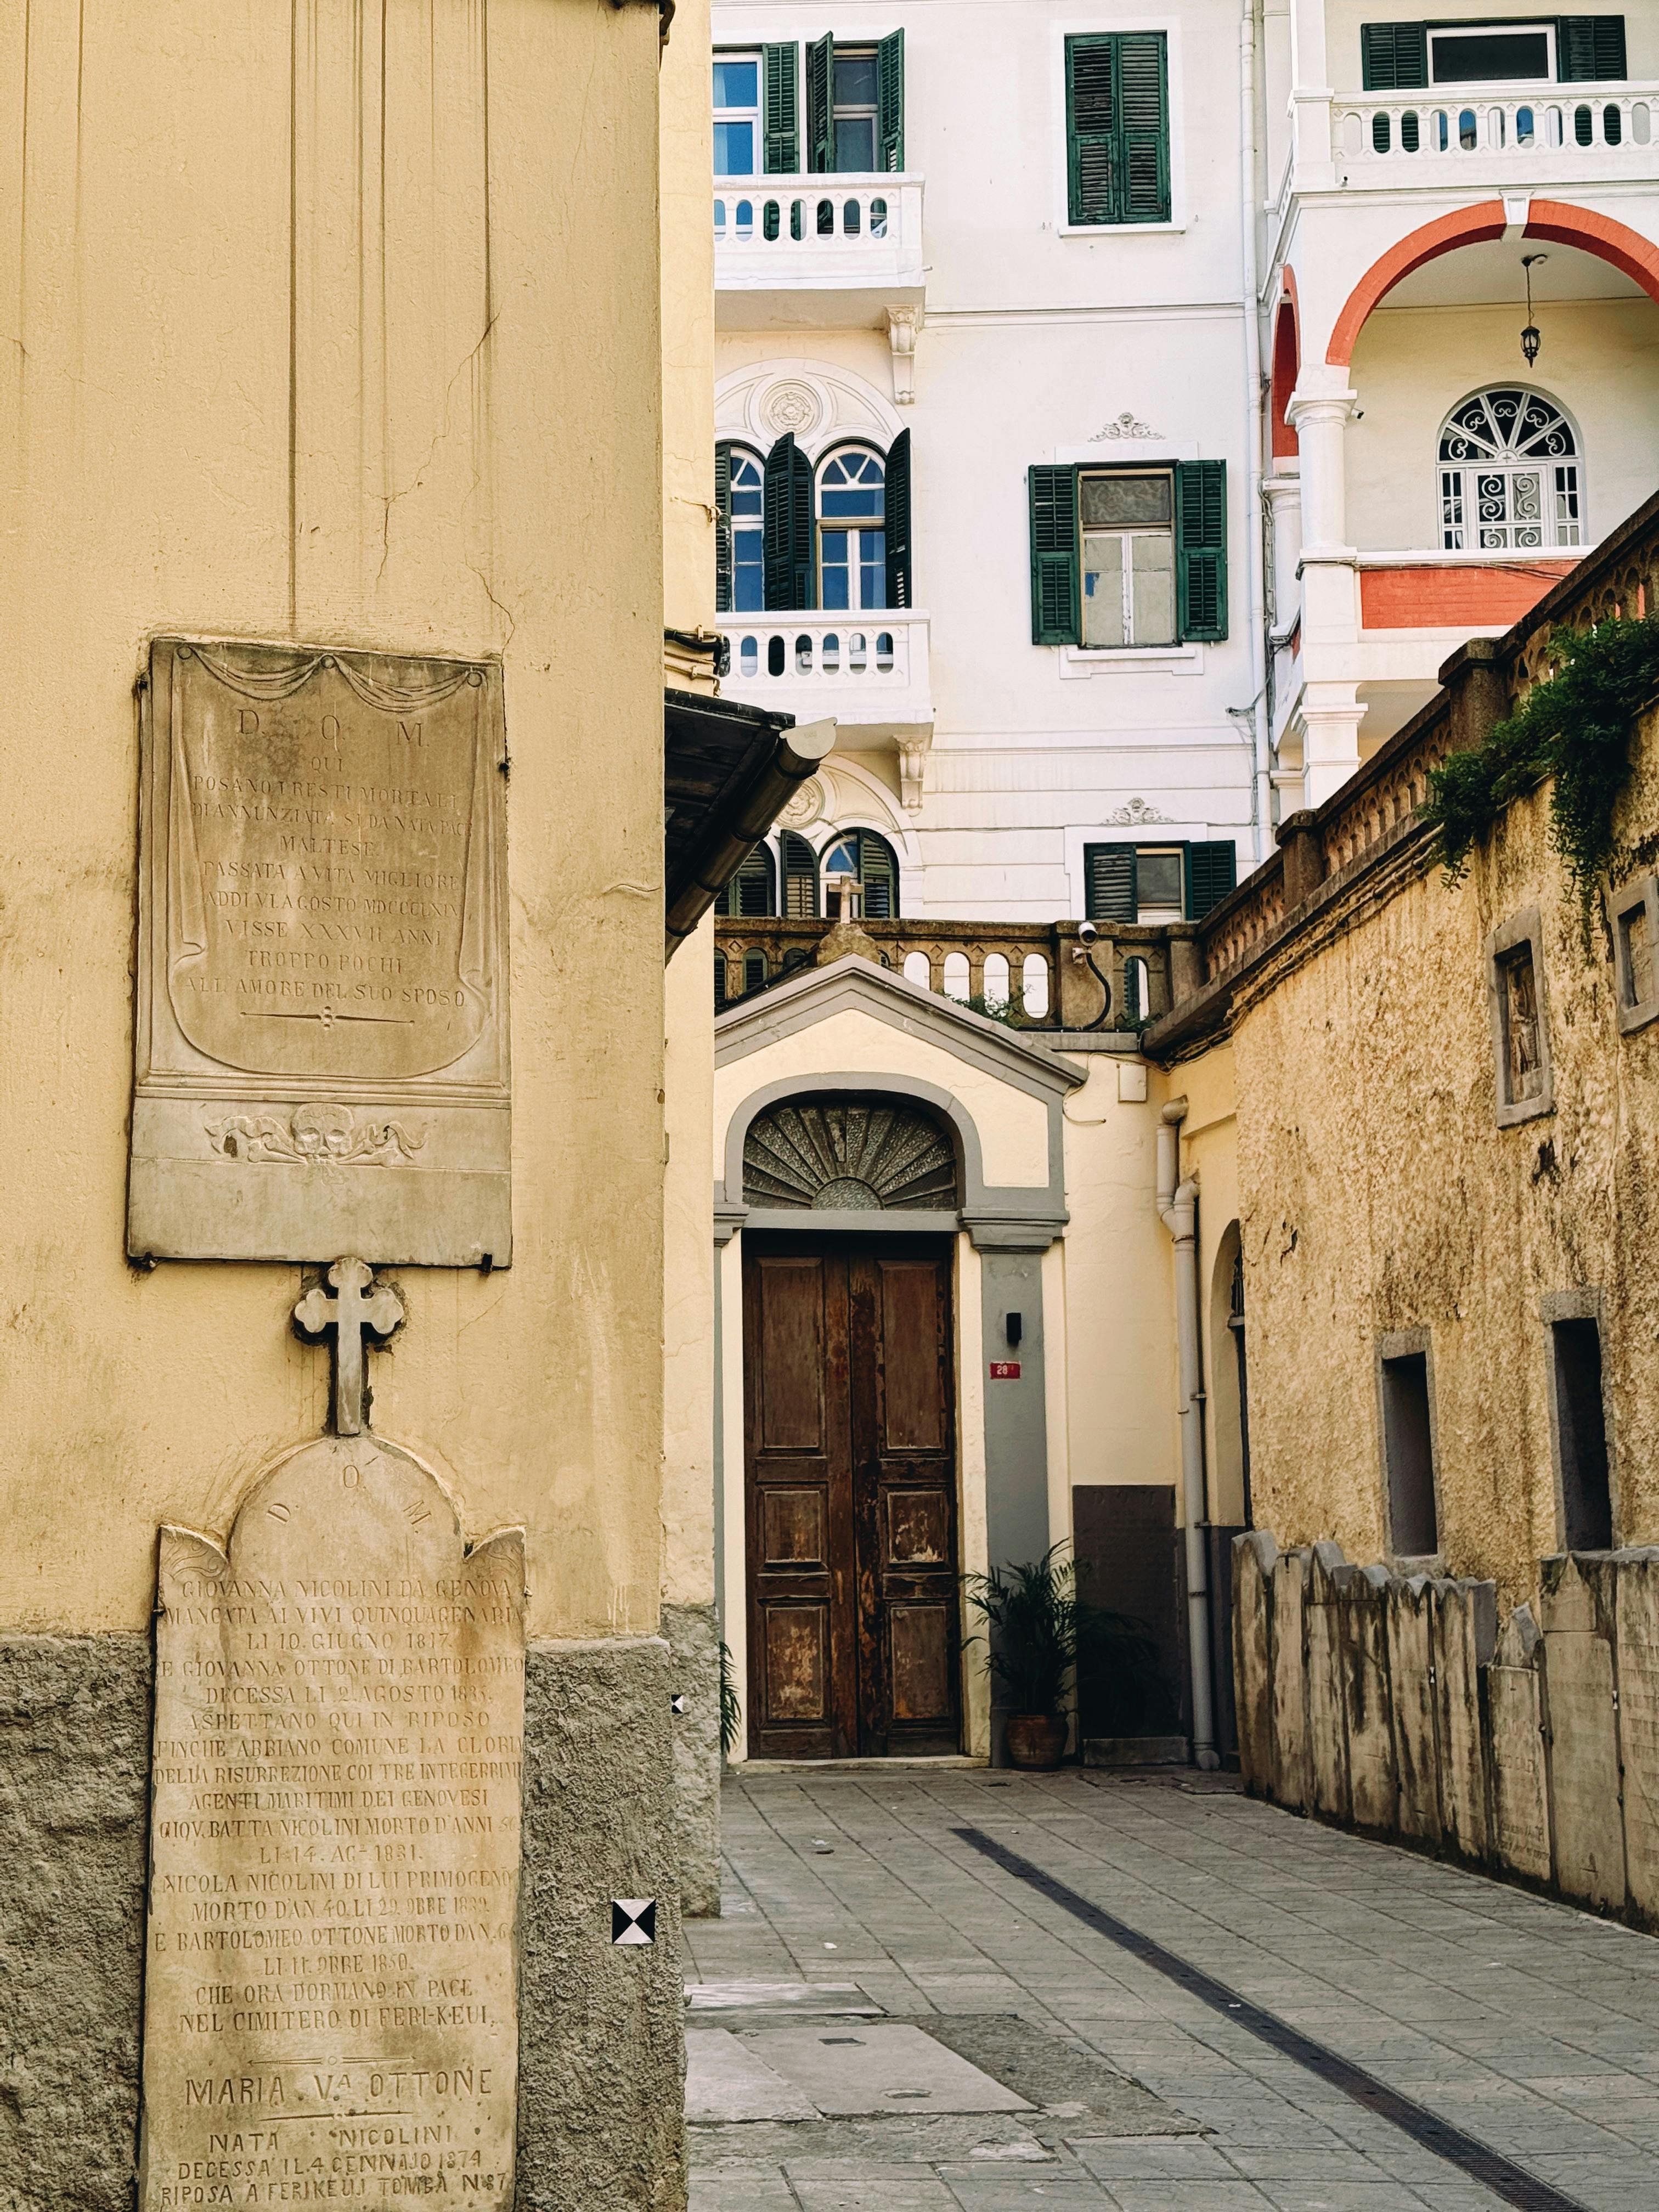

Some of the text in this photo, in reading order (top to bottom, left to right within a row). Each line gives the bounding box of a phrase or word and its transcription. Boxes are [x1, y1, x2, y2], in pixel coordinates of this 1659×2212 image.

[311, 757, 343, 774] QUI
[292, 781, 351, 800] RESTI
[360, 787, 456, 808] MORTALI
[203, 861, 285, 880] PASSATA
[312, 866, 354, 884] VITA
[364, 870, 458, 891] MIGLIORE
[205, 890, 248, 907] ADDI
[282, 894, 356, 912] AGOSTO
[225, 919, 288, 938] VISSE
[391, 929, 441, 946] ANNI
[246, 950, 402, 974] TROPPO POCHI
[312, 983, 347, 1000] DEL
[353, 983, 392, 1001] SUO
[402, 988, 465, 1007] SPOSO
[997, 1365, 1008, 1375] 28
[182, 1579, 512, 1599] GIOVANNA NICOLINI DA GENOVA
[164, 1606, 523, 1626] MANCATA AI VIVI QUINQUAGENARIA
[247, 1633, 268, 1650] LI
[311, 1632, 394, 1650] GIUGNO
[161, 1656, 523, 1677] E GIOVANNA OTTONE DI BARTOLOMEO
[205, 1686, 296, 1705] DECESSA
[304, 1686, 325, 1703] LI
[362, 1685, 444, 1702] AGOSTO
[189, 1711, 490, 1731] ASPETTANO QUI IN RIPOSO
[236, 1739, 321, 1757] ABBIANO
[331, 1737, 409, 1756] COMUNE
[419, 1737, 446, 1754] LA
[154, 1768, 209, 1784] DELLA
[215, 1764, 342, 1784] RISURREZIONE
[347, 1763, 373, 1781] COI
[379, 1763, 415, 1781] TRE
[189, 1788, 488, 1810] AGENTI MARITIMI DEI GENOVESI
[278, 1817, 360, 1837] NICOLINI
[365, 1816, 431, 1835] MORTO
[162, 1874, 239, 1893] NICOLA
[247, 1872, 336, 1892] NICOLINI
[344, 1871, 361, 1889] DI
[368, 1871, 399, 1889] LUI
[191, 1900, 267, 1921] MORTO
[155, 1933, 166, 1952] E
[177, 1928, 303, 1951] BARTOLOMEO
[312, 1925, 387, 1946] OTTONE
[392, 1923, 450, 1944] MORTO
[264, 1957, 283, 1976] LI
[196, 1979, 473, 2005] CHE ORA DORMANO IN PACE
[179, 2013, 224, 2033] NEL
[233, 2008, 340, 2032] CIMITERO
[349, 2007, 369, 2028] DI
[185, 2076, 285, 2106] MARIA
[370, 2068, 492, 2098] OTTONE
[210, 2125, 452, 2153] NATA NICOLINI
[178, 2159, 270, 2180] DECESSA
[161, 2183, 233, 2206] RIPOSA
[246, 2183, 259, 2203] A
[377, 2170, 448, 2196] TOMBA
